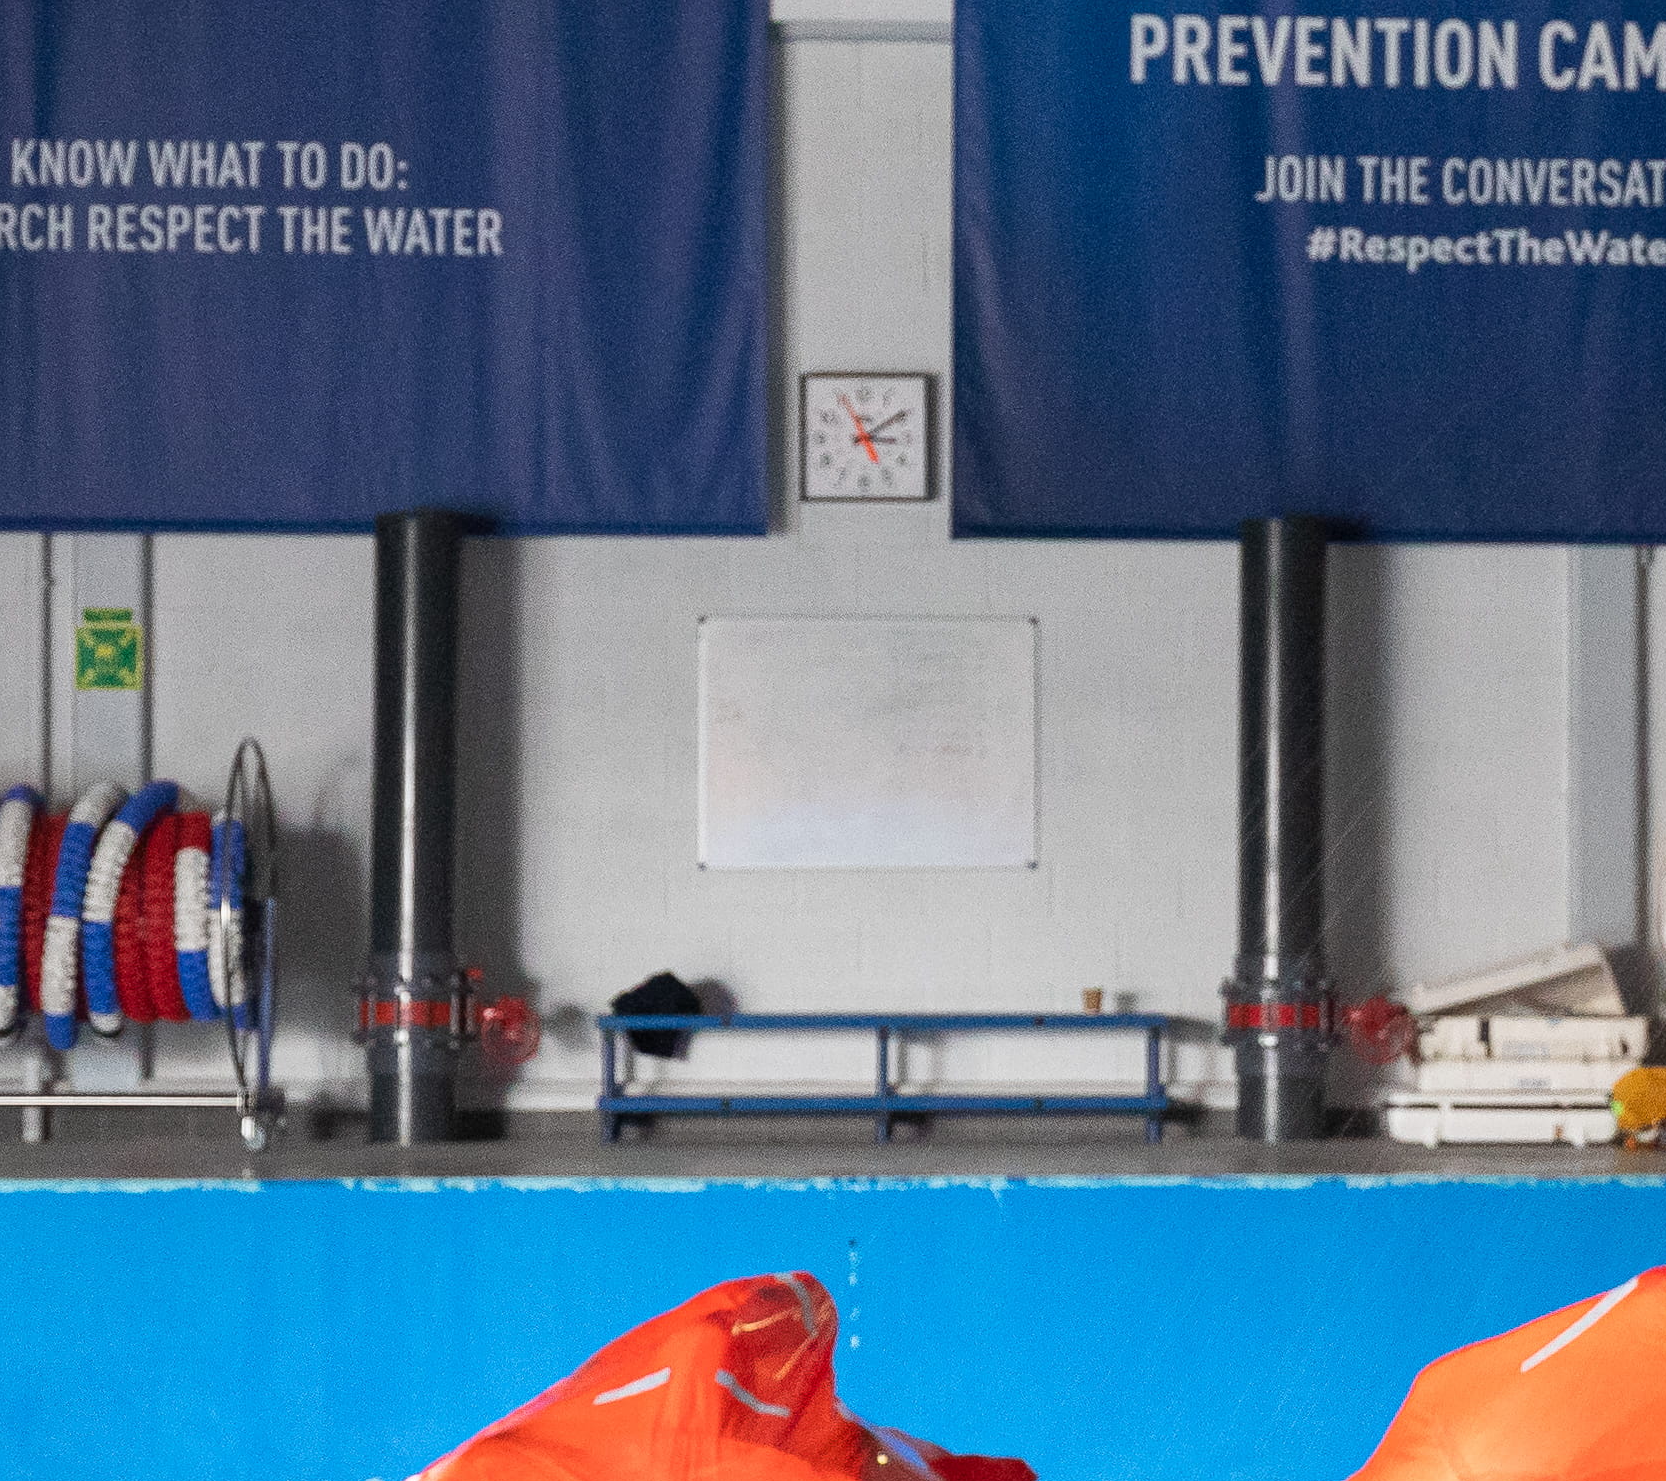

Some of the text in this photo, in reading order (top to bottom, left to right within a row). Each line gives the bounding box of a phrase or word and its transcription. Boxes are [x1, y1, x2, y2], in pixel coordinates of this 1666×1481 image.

[1130, 14, 1518, 89] PREVENTION
[11, 139, 408, 191] KNOW WHAT TO DO:
[1256, 153, 1346, 204] JOIN
[1358, 155, 1429, 205] THE
[87, 204, 265, 253] RESPECT
[278, 205, 351, 254] THE
[363, 208, 503, 256] WATER
